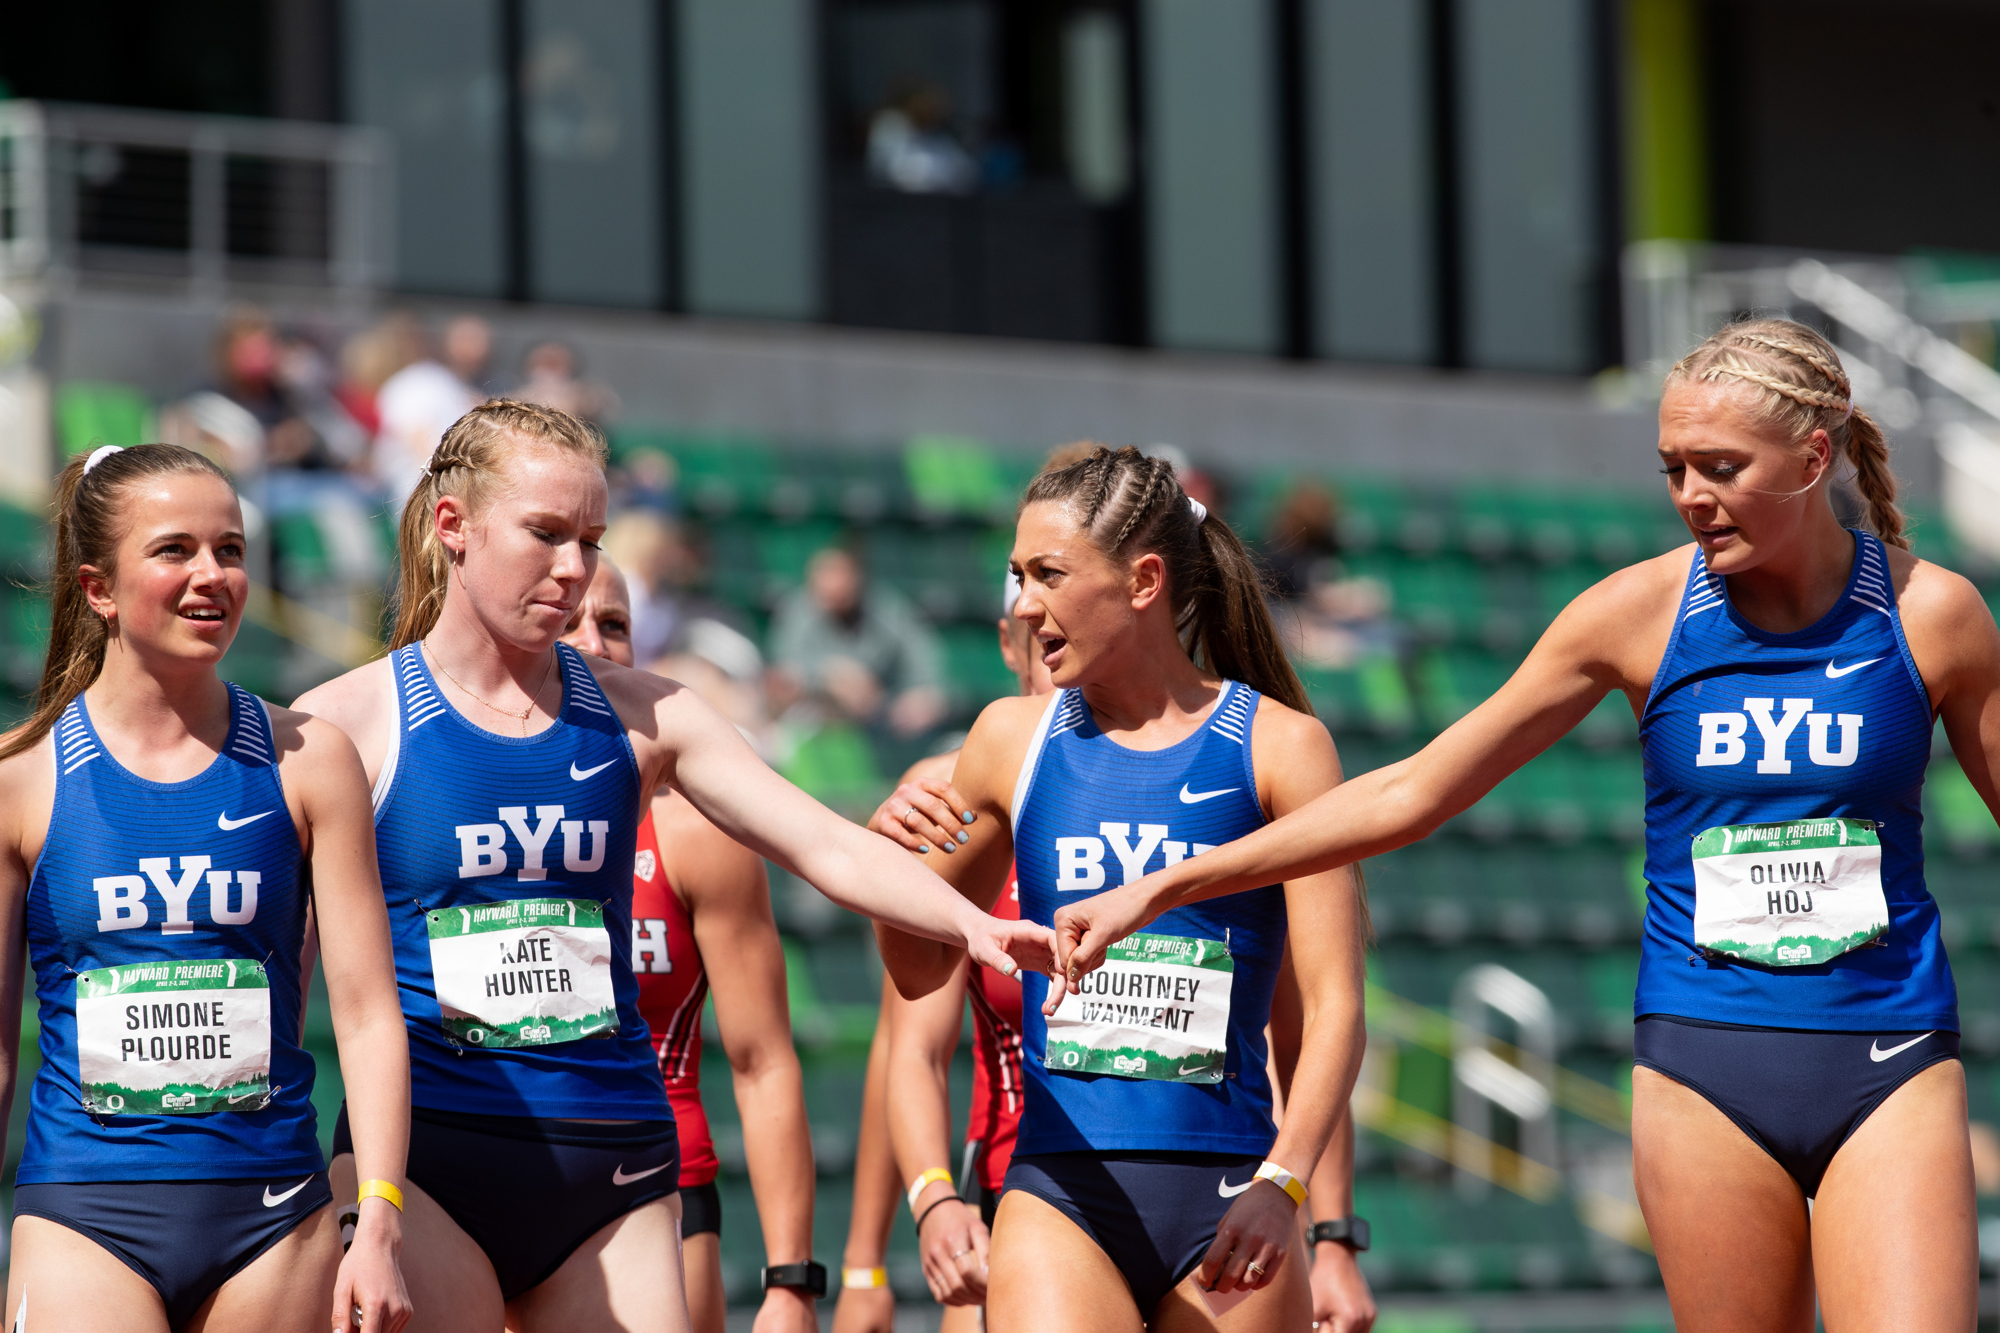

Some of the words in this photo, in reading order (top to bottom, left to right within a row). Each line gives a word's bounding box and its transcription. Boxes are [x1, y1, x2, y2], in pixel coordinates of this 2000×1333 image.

[1695, 697, 1864, 774] BYU
[455, 804, 609, 882] BYU
[1735, 826, 1781, 843] HAYWARD
[1786, 823, 1836, 839] PREMIERE
[1750, 860, 1826, 885] OLIVIA
[92, 855, 262, 935] BYU
[1767, 890, 1813, 915] HOJ
[473, 904, 519, 923] HAYWARD
[523, 903, 566, 917] PREMIERE
[499, 937, 553, 964] KATE
[1144, 939, 1194, 957] PREMIERE
[122, 966, 170, 983] HAYWARD
[174, 964, 225, 979] PREMIERE
[484, 968, 573, 998] HUNTER
[1080, 971, 1201, 1003] COURTNEY
[126, 1001, 225, 1031] SIMONE
[1081, 1001, 1195, 1033] WAYMENT
[121, 1034, 232, 1062] PLOURDE
